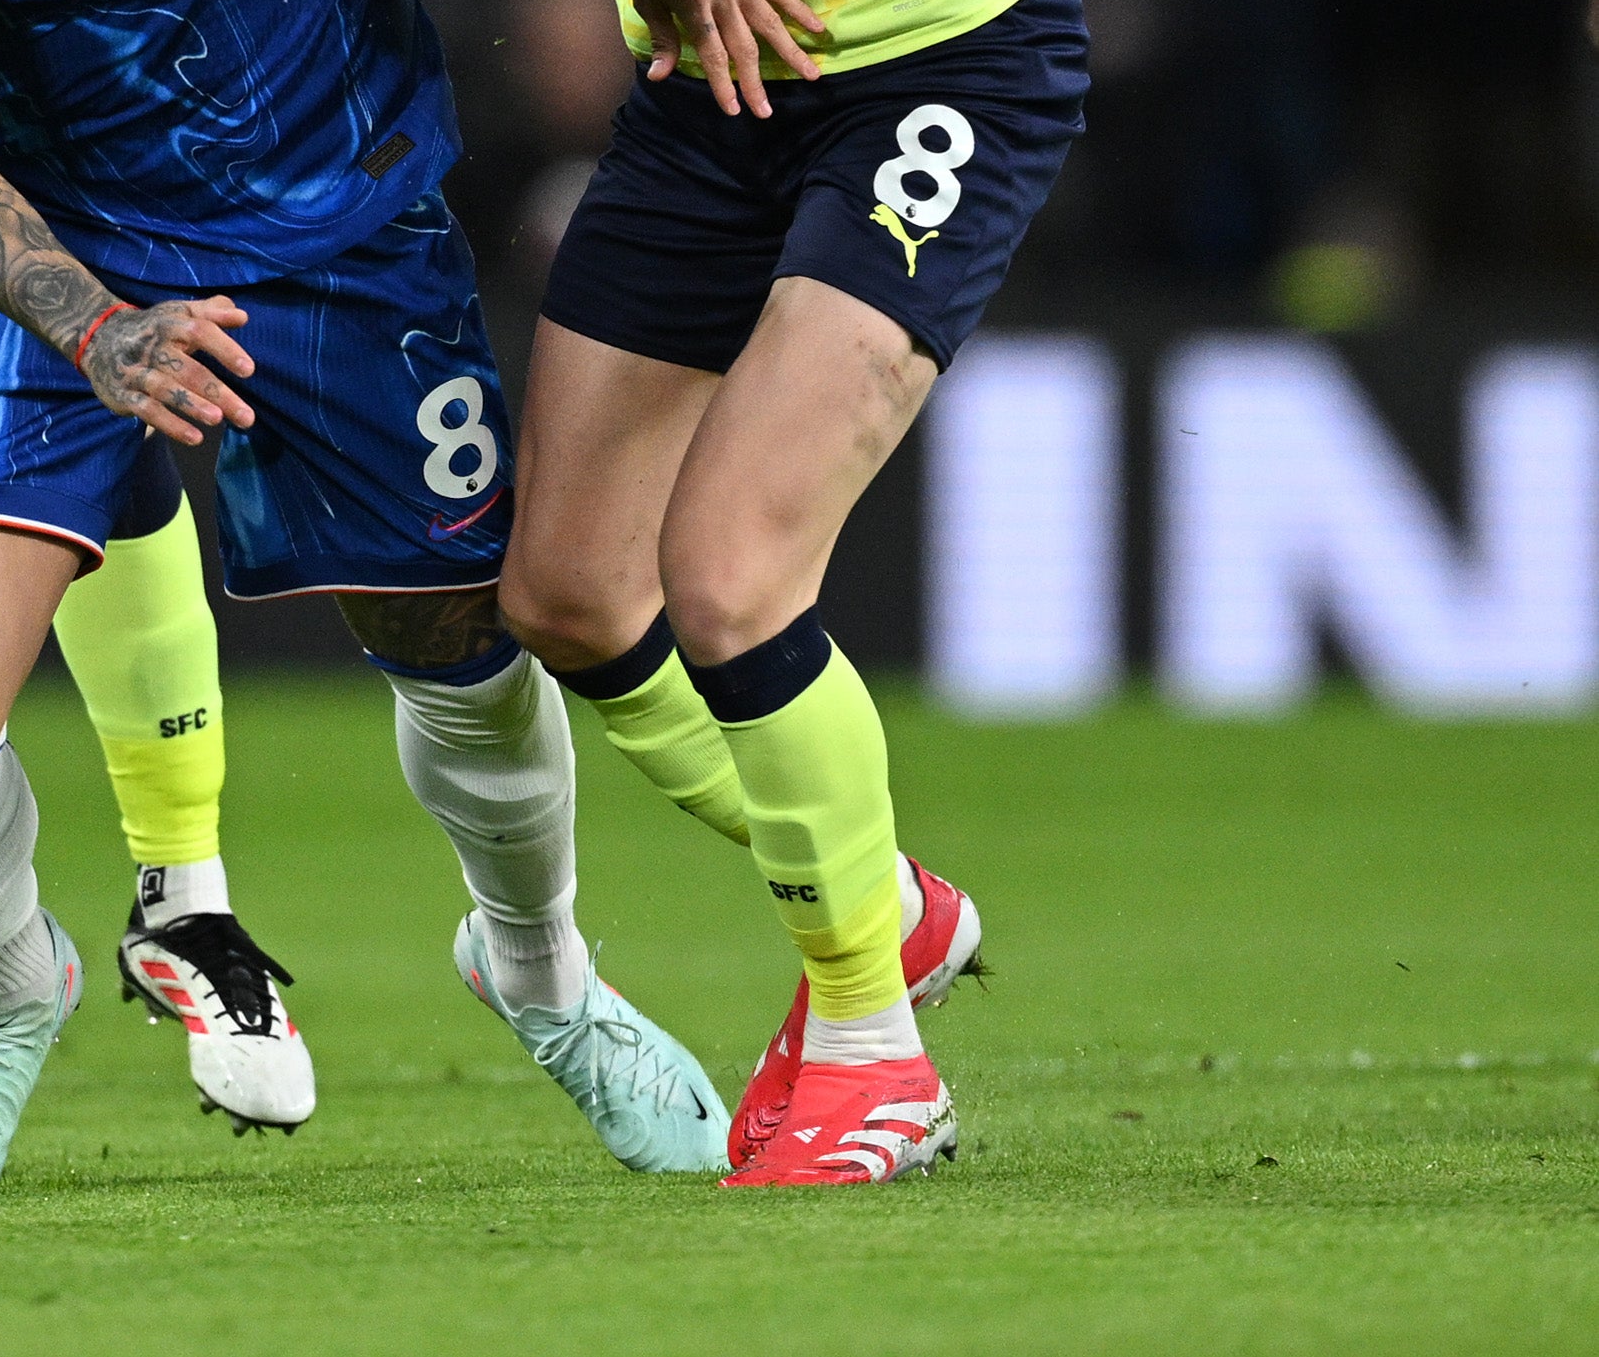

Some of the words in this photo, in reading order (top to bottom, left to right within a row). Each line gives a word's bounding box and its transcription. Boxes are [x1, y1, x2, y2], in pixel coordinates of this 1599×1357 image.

[873, 104, 976, 228] 8
[416, 376, 498, 499] 8
[159, 706, 208, 739] SFC
[768, 880, 819, 903] SFC
